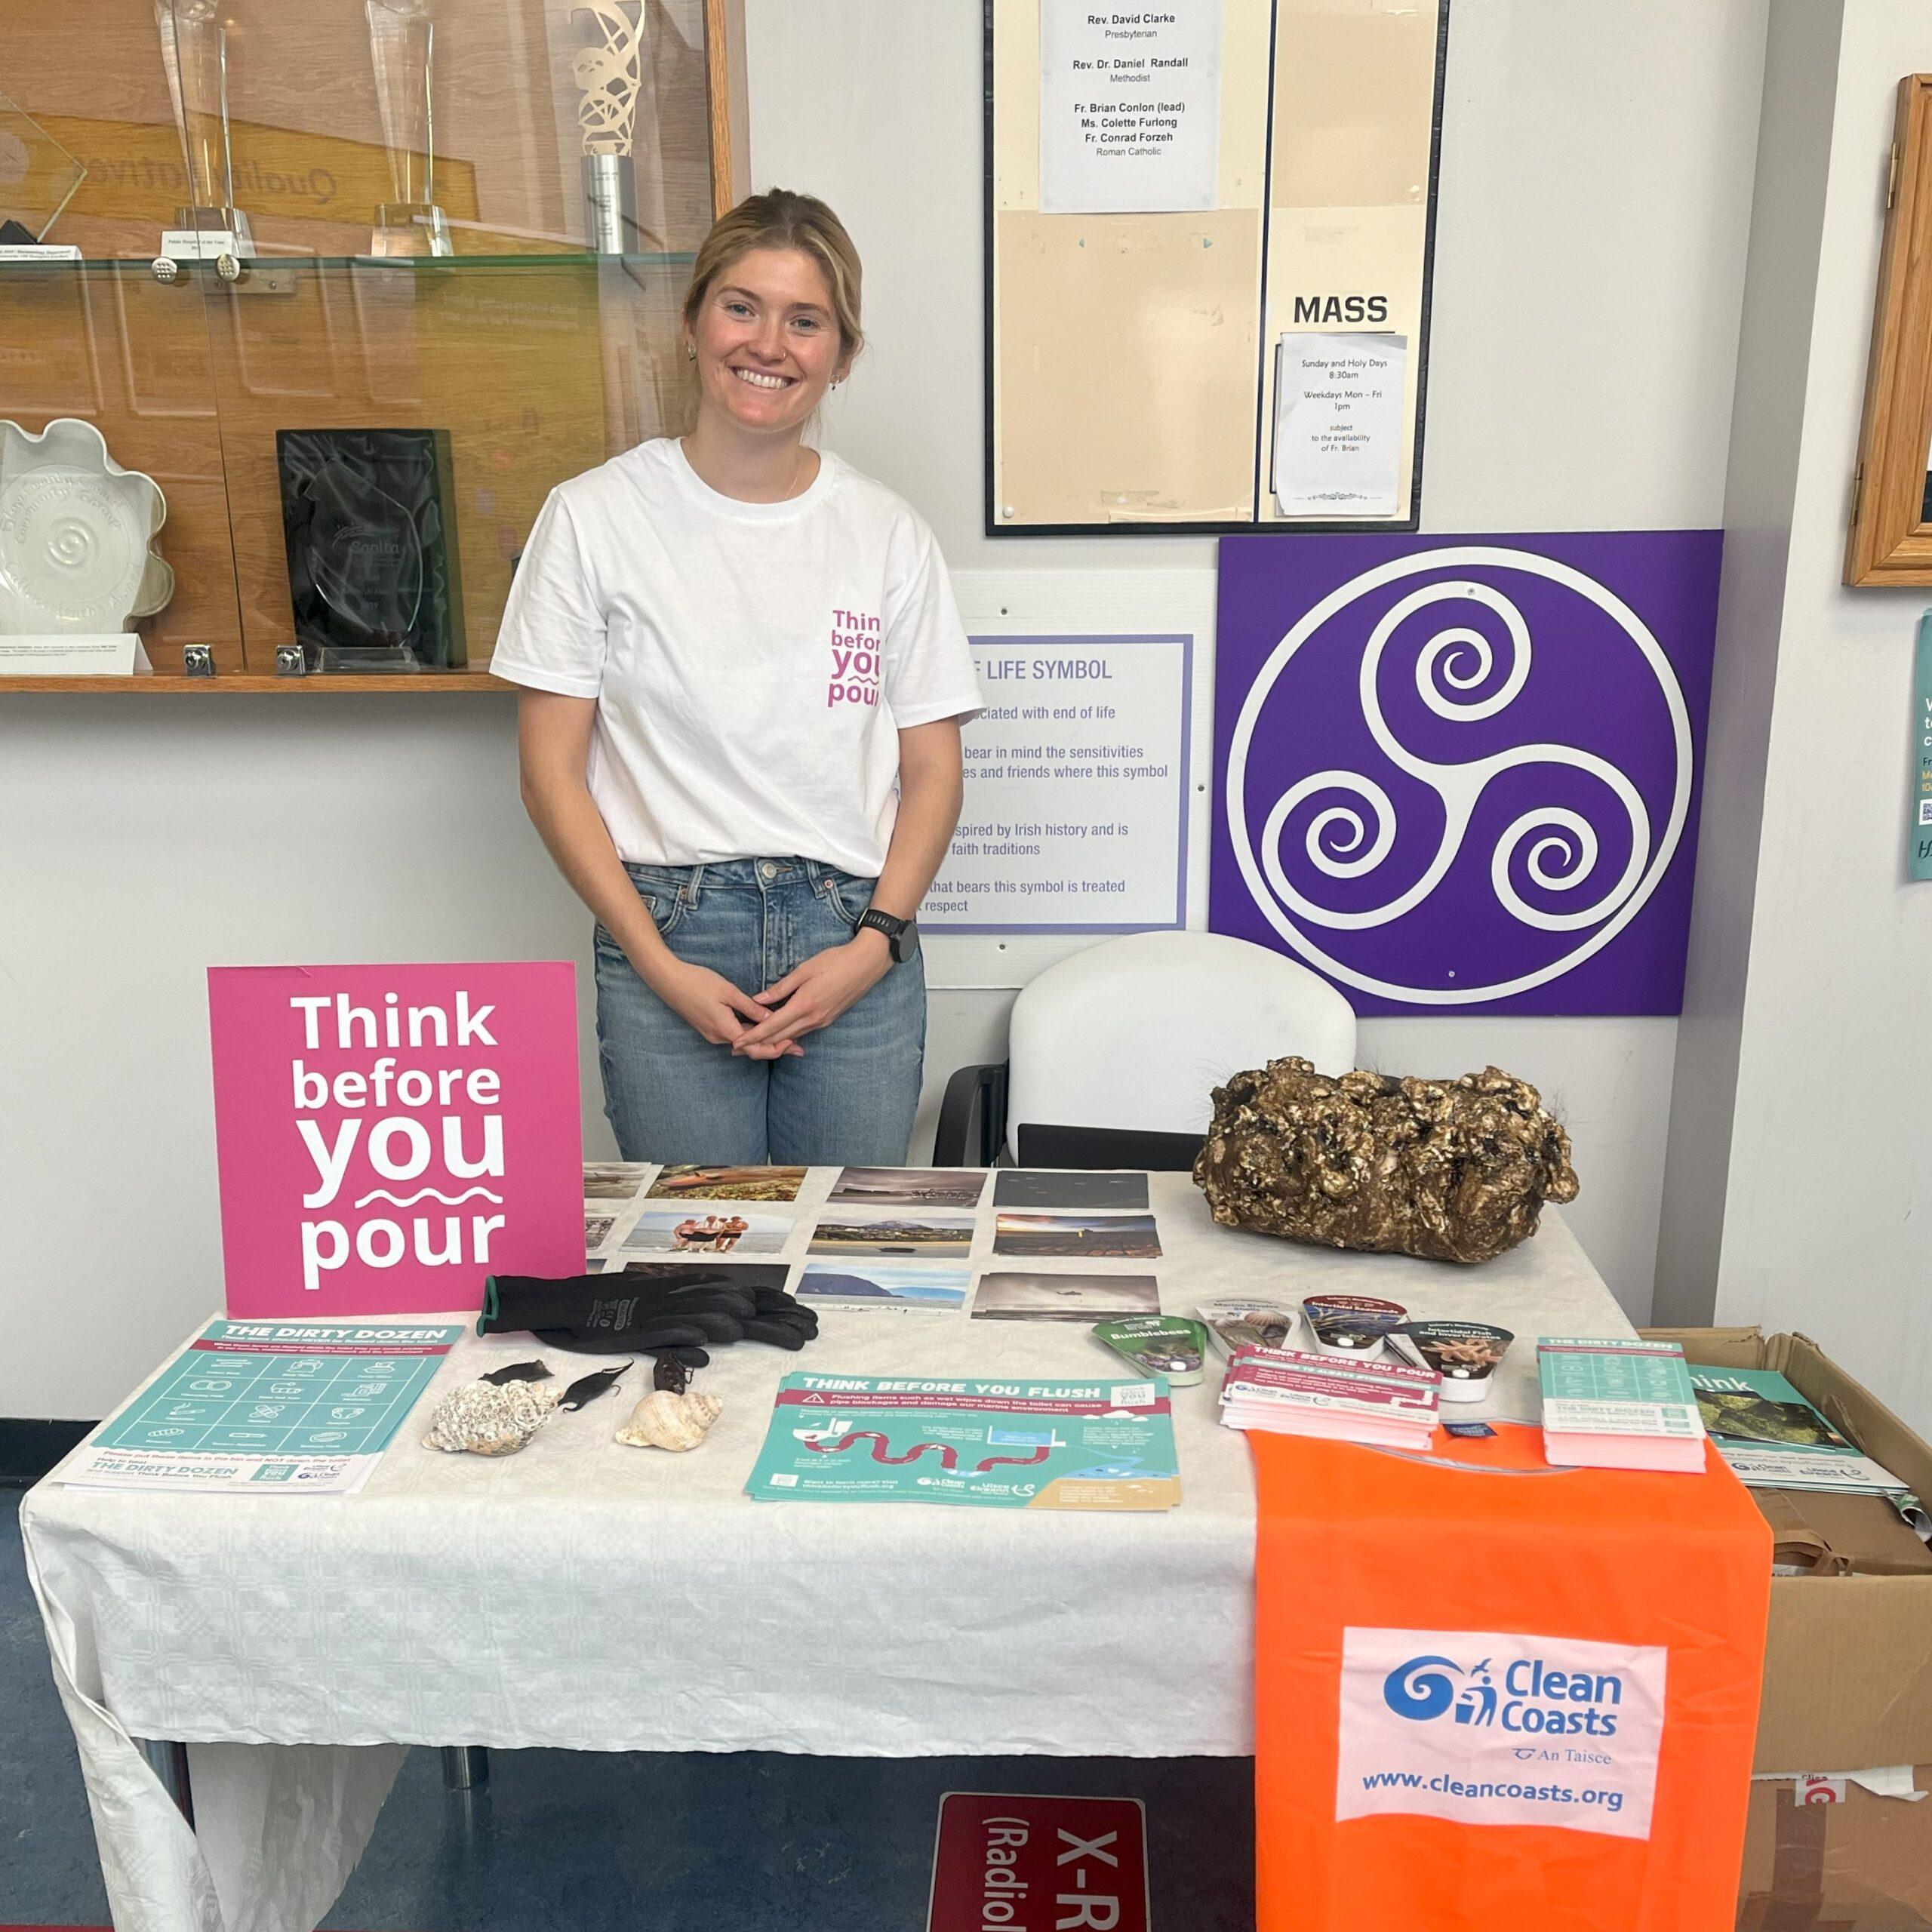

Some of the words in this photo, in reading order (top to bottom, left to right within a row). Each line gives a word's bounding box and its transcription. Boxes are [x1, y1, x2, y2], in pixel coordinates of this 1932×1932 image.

[1088, 15, 1109, 25] Rev.
[1112, 14, 1140, 24] David
[1143, 14, 1175, 23] Clarke
[1105, 30, 1157, 39] Presbyterian
[1072, 60, 1094, 69] Rev.
[1097, 60, 1111, 69] Dr.
[1114, 59, 1145, 69] Daniel
[1150, 57, 1188, 68] Randall
[1110, 74, 1150, 82] Methodist
[1075, 104, 1088, 113] Fr.
[1090, 103, 1115, 112] Brian
[1118, 103, 1155, 112] Conlon
[1157, 102, 1185, 113] (lead)
[1081, 119, 1099, 128] Ms.
[1101, 118, 1136, 128] Colette
[1139, 118, 1177, 128] Furlong
[1085, 134, 1097, 142] Fr.
[1100, 133, 1137, 142] Conrad
[1140, 132, 1173, 142] Forzeh
[1128, 147, 1162, 155] Catholic
[1294, 295, 1388, 323] MASS
[1302, 359, 1328, 368] Sunday
[1331, 359, 1346, 368] and
[1348, 359, 1367, 368] Holy
[1369, 359, 1387, 368] Days
[1329, 371, 1358, 379] 8:30am
[1304, 391, 1342, 400] Weekdays
[1372, 390, 1382, 398] Fri
[1335, 403, 1350, 411] 1pm
[1330, 424, 1353, 432] subject
[1334, 434, 1370, 443] availability
[832, 610, 880, 632] Thin
[831, 629, 880, 651] befor
[987, 661, 1026, 679] LIFE
[1032, 660, 1112, 679] SYMBOL
[979, 706, 1018, 720] ciated
[1022, 706, 1049, 719] with
[1053, 706, 1076, 719] end
[1080, 706, 1093, 718] of
[1096, 706, 1115, 718] life
[964, 746, 992, 759] bear
[995, 746, 1007, 758] in
[1011, 746, 1042, 758] mind
[1046, 746, 1066, 758] the
[1069, 745, 1143, 758] sensitivities
[981, 766, 1003, 779] and
[1007, 765, 1050, 778] friends
[1054, 765, 1093, 778] where
[1097, 764, 1119, 777] this
[1123, 764, 1168, 780] symbol
[955, 823, 992, 840] spired
[997, 823, 1011, 838] by
[1014, 823, 1041, 835] Irish
[1045, 823, 1088, 838] history
[1091, 823, 1114, 835] and
[1118, 823, 1128, 835] is
[952, 842, 979, 855] faith
[983, 842, 1040, 855] traditions
[930, 881, 952, 894] that
[957, 881, 990, 893] bears
[994, 881, 1017, 893] this
[1020, 880, 1064, 896] symbol
[1068, 880, 1078, 892] is
[1082, 880, 1125, 892] treated
[925, 900, 968, 914] respect
[290, 990, 498, 1049] Think
[292, 1058, 500, 1109] before
[295, 1115, 505, 1209] you
[301, 1214, 506, 1290] pour
[226, 1325, 274, 1337] THE
[275, 1327, 352, 1338] DIRTY
[354, 1329, 448, 1339] DOZEN
[1110, 1330, 1191, 1340] Bumblebees
[1621, 1341, 1673, 1349] DOZEN
[1254, 1346, 1297, 1358] THINK
[1300, 1353, 1358, 1367] BEFORE
[1363, 1361, 1392, 1372] YOU
[1395, 1367, 1436, 1379] POUR
[803, 1377, 870, 1391] THINK
[876, 1381, 967, 1393] BEFORE
[975, 1384, 1020, 1395] YOU
[1029, 1387, 1100, 1399] FLUSH
[1690, 1374, 1755, 1392] ink
[125, 1463, 176, 1472] DIRTY
[177, 1466, 238, 1475] DOZEN
[1506, 1660, 1622, 1705] Clean
[1502, 1700, 1617, 1737] Coasts
[1538, 1749, 1559, 1761] An
[1564, 1749, 1611, 1765] Taisce
[1362, 1773, 1623, 1812] www.cleancoasts.org
[982, 1817, 1029, 1932] (Radiol
[1056, 1828, 1120, 1930] X-R
